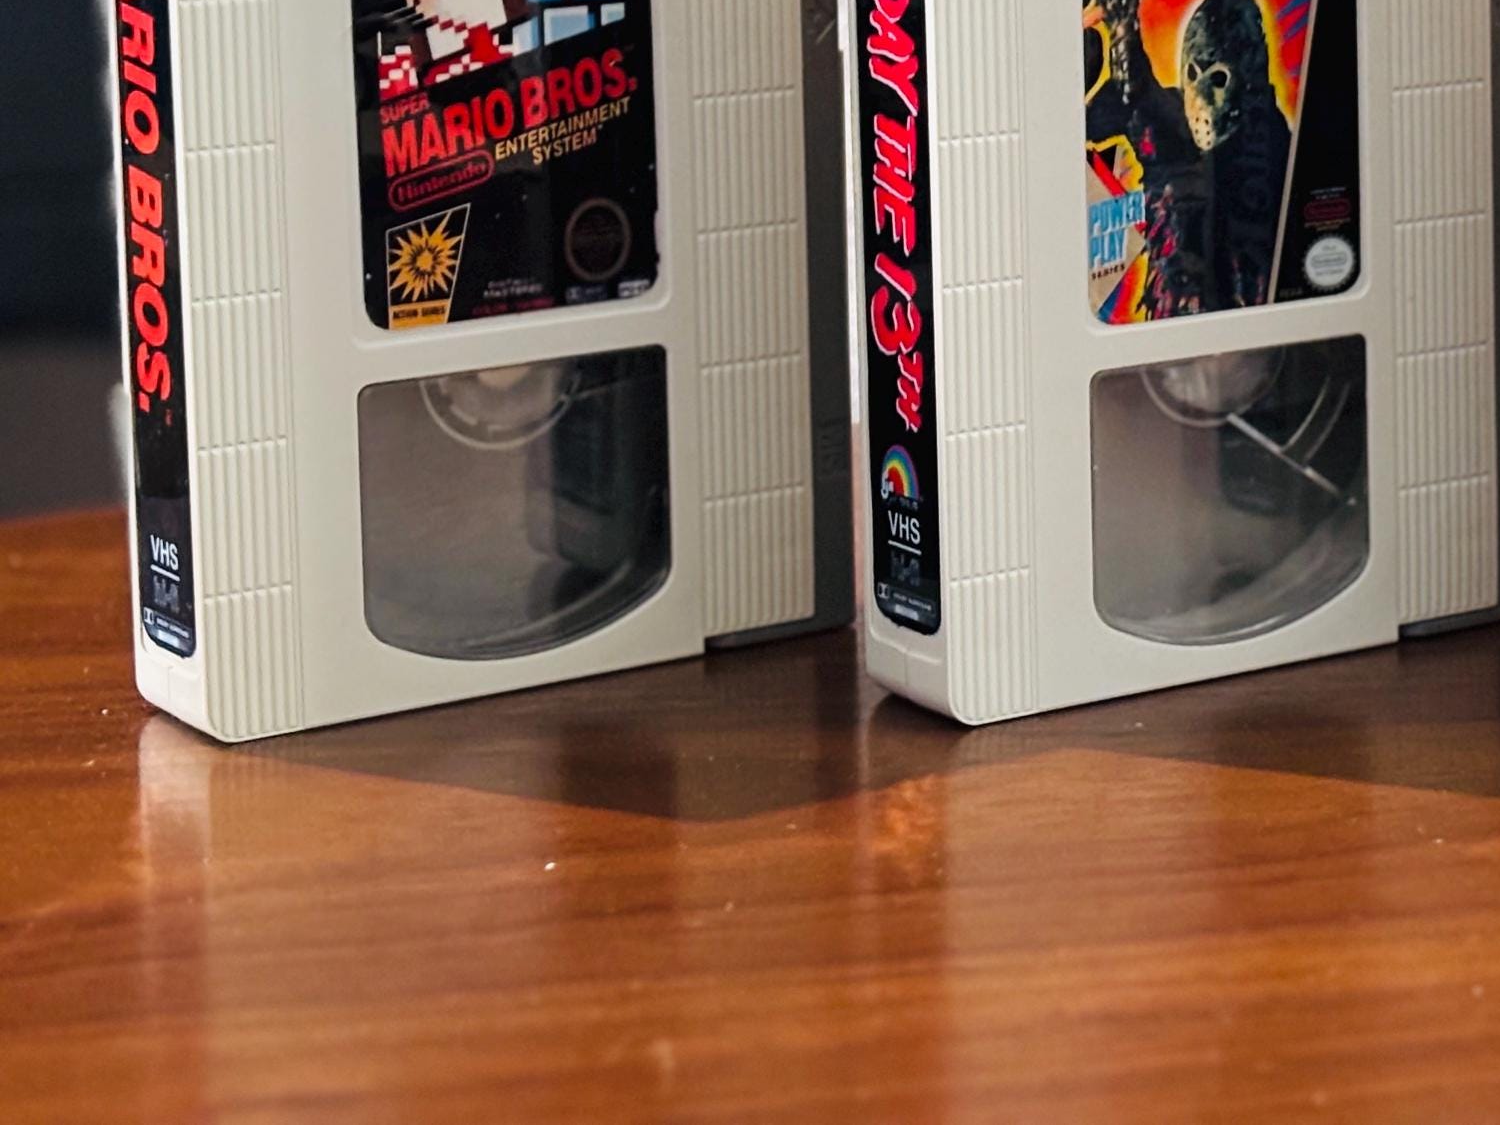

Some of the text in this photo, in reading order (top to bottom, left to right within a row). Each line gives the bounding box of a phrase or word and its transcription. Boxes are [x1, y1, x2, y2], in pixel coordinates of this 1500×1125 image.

[380, 92, 430, 124] SUPER
[382, 48, 638, 176] MARIO BROS.
[495, 96, 631, 161] ENTERTAINMENT
[532, 128, 598, 165] SYSTEM
[398, 161, 487, 201] Nintendo
[874, 114, 917, 257] THE
[128, 165, 171, 412] BROS.
[888, 510, 921, 545] VHS
[150, 534, 179, 571] VHS
